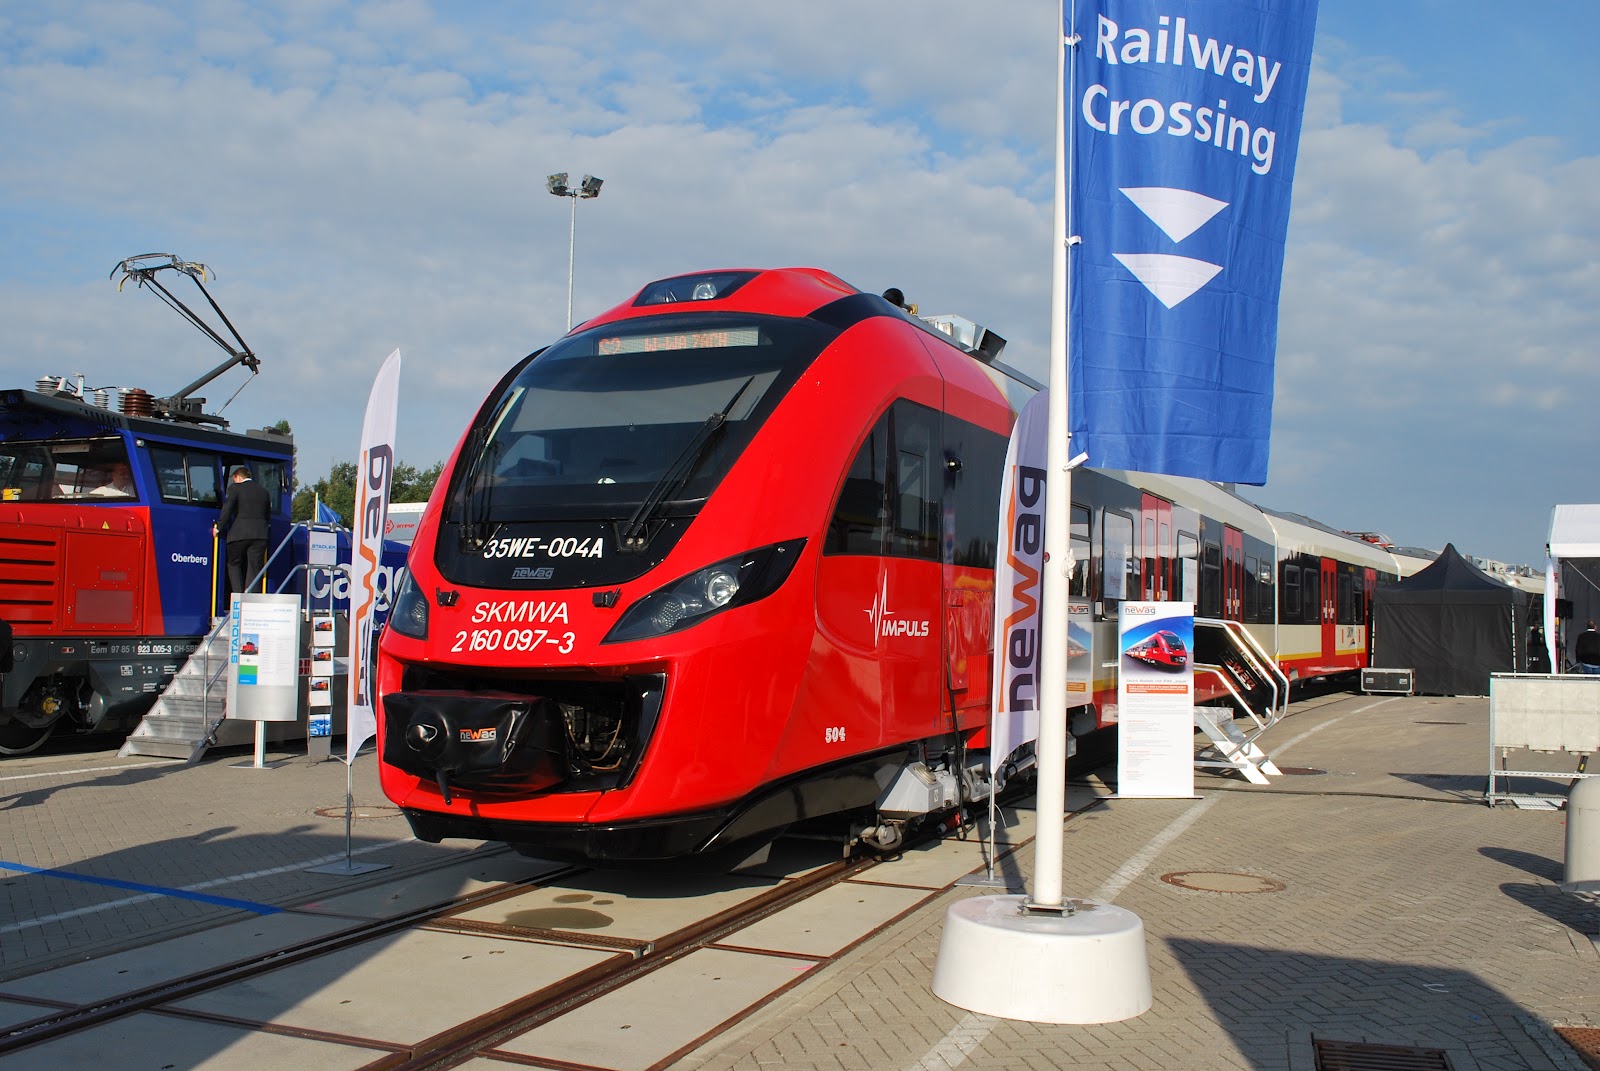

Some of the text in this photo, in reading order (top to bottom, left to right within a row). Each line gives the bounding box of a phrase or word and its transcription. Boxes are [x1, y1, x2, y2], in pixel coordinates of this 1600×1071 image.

[1096, 13, 1282, 104] Railway
[1082, 84, 1276, 175] Crossing
[483, 537, 604, 558] 35WE-004A
[171, 552, 208, 566] Oberberg
[512, 567, 555, 580] newag
[998, 464, 1048, 712] newag
[471, 601, 569, 624] SKMWA
[1125, 605, 1156, 616] newag
[231, 601, 240, 664] STADLER
[882, 619, 929, 637] IMPULS
[91, 645, 108, 654] Eem
[111, 645, 120, 653] 97
[121, 645, 130, 653] 85
[132, 645, 136, 653] 1
[137, 644, 151, 654] 923
[152, 644, 172, 654] 005-3
[451, 629, 576, 654] 2 160 097-3
[459, 727, 497, 743] newag
[825, 726, 846, 743] 504
